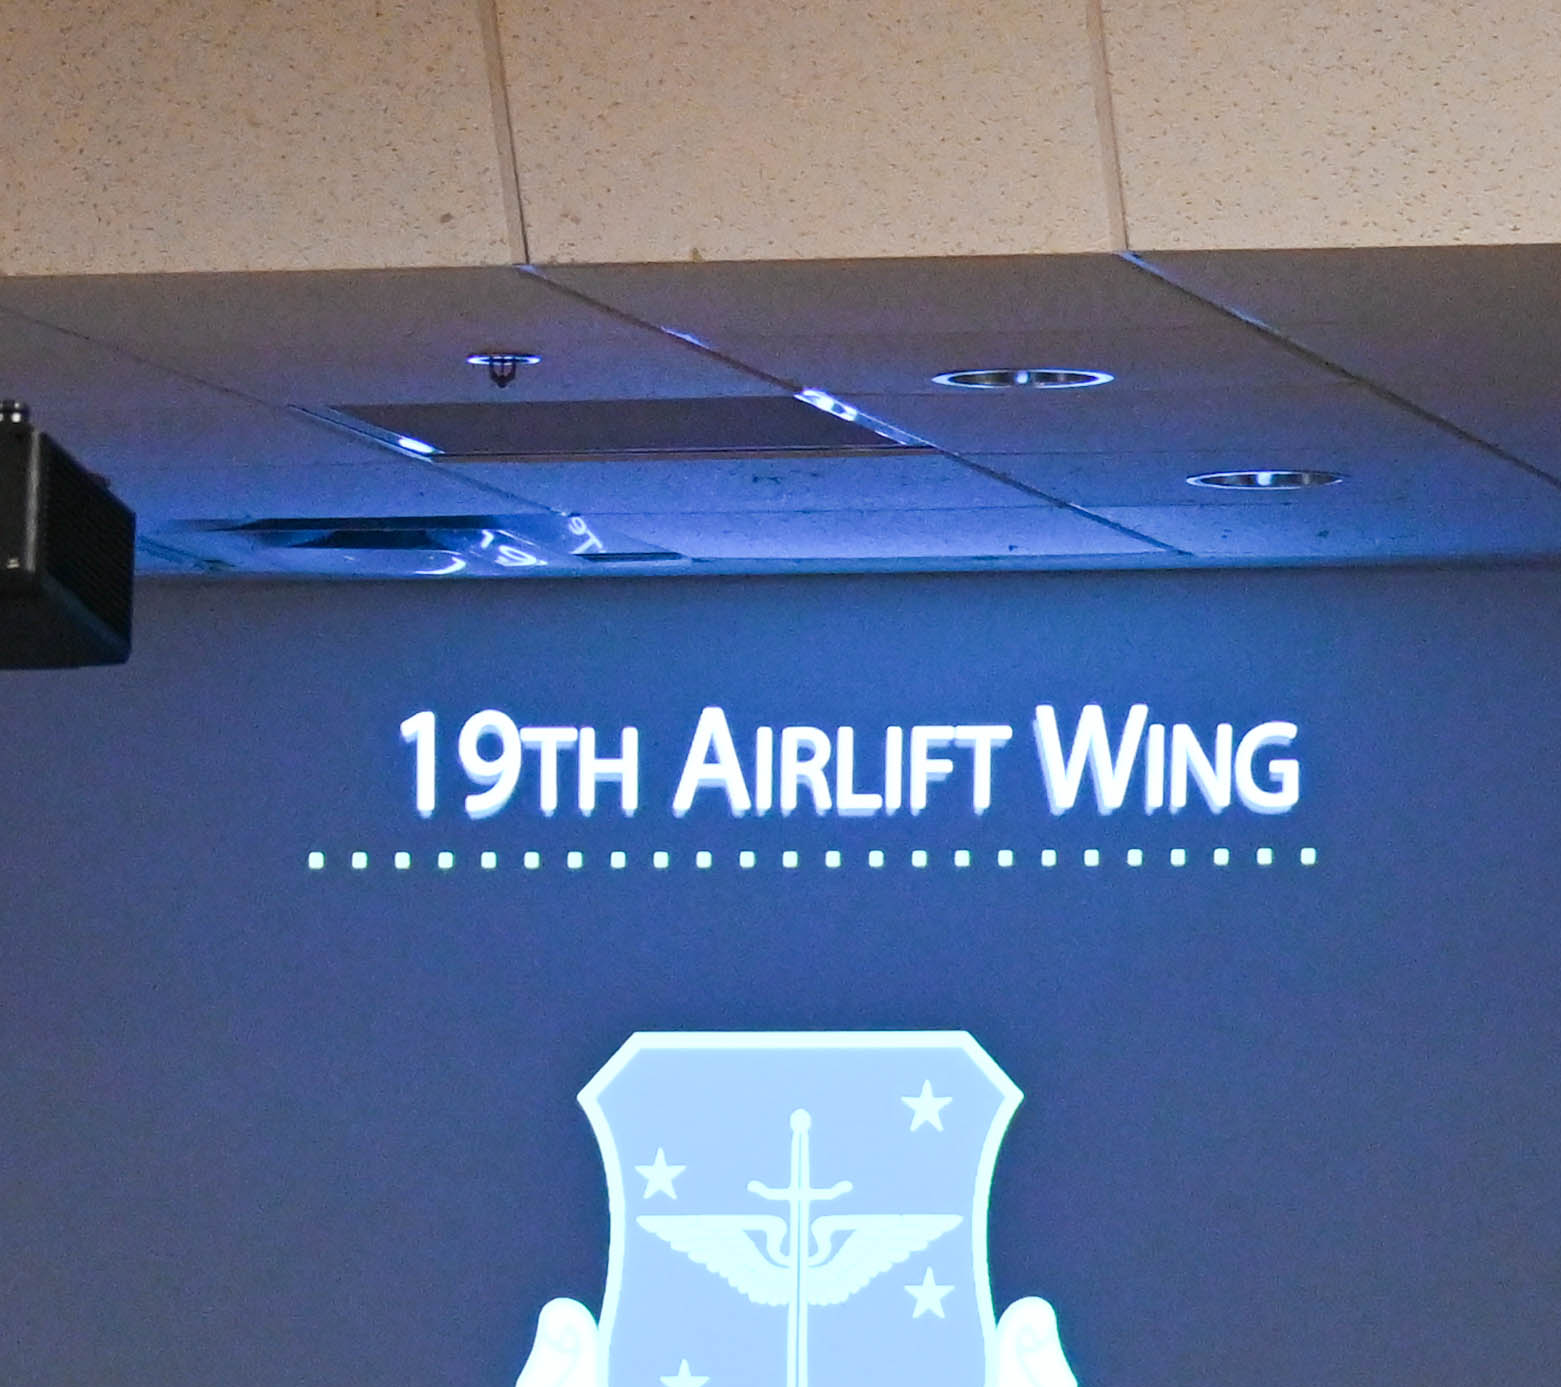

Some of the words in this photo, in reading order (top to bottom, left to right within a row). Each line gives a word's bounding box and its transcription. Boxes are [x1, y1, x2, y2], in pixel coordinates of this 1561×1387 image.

[398, 708, 638, 816] 19TH
[673, 706, 1013, 814] AIRLIFT
[1035, 703, 1299, 814] WING
